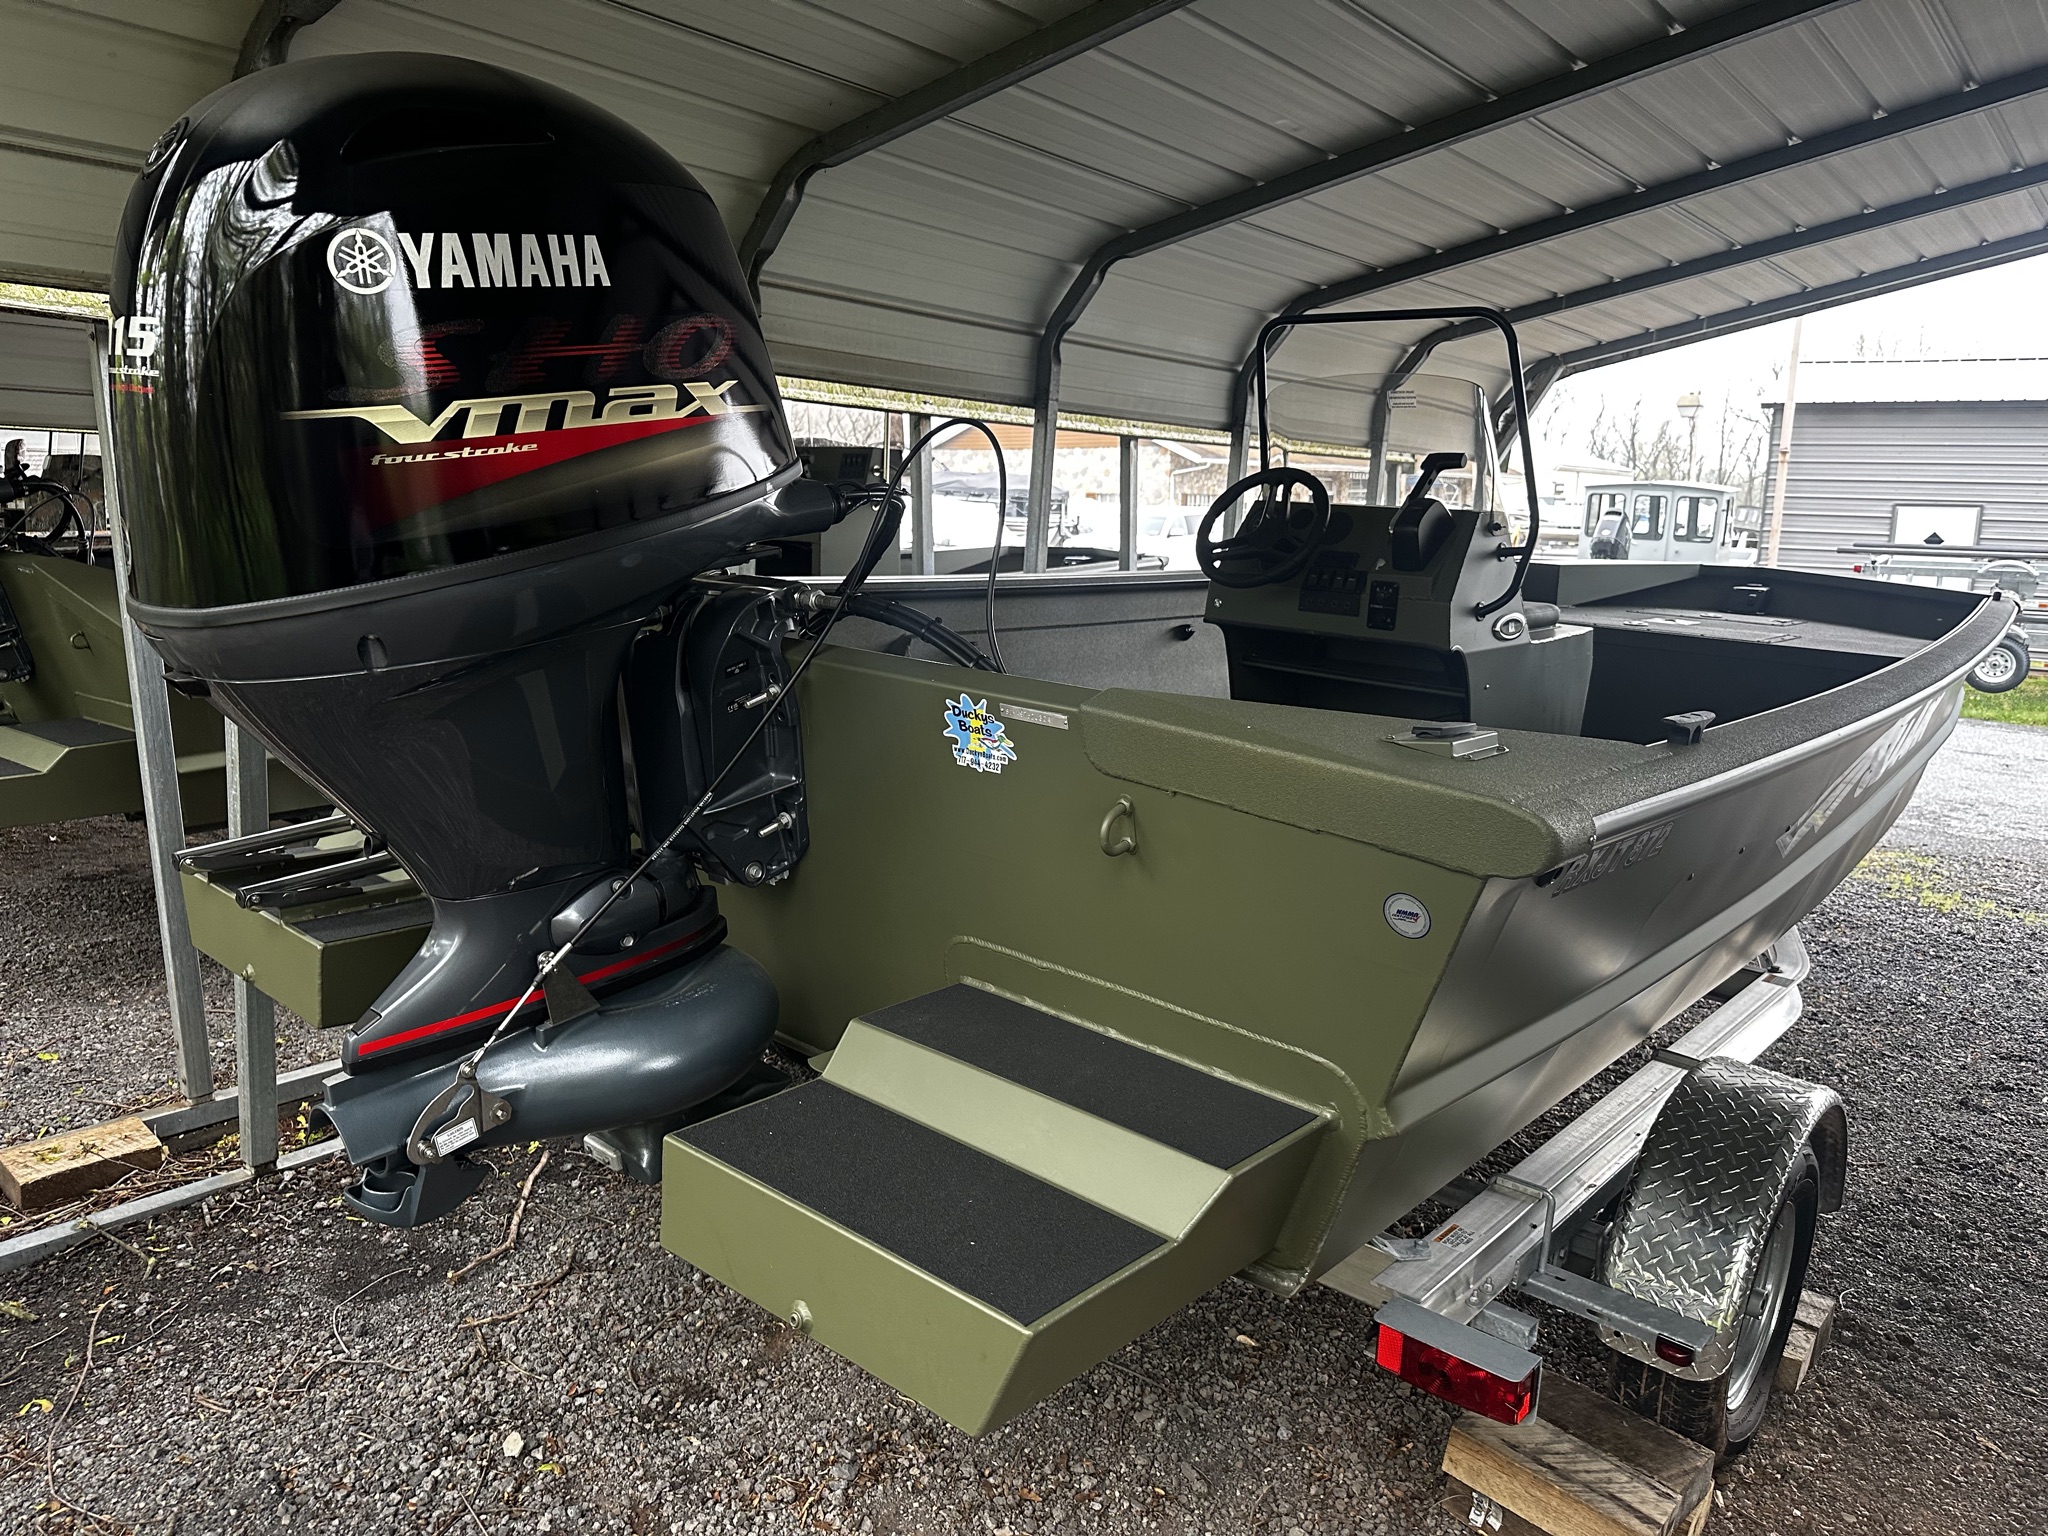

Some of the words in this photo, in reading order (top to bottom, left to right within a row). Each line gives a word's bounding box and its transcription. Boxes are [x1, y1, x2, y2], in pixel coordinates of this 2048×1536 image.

[397, 232, 611, 289] YAMAHA
[327, 312, 737, 403] SHO
[951, 704, 994, 725] Duckys
[957, 719, 993, 737] Boats
